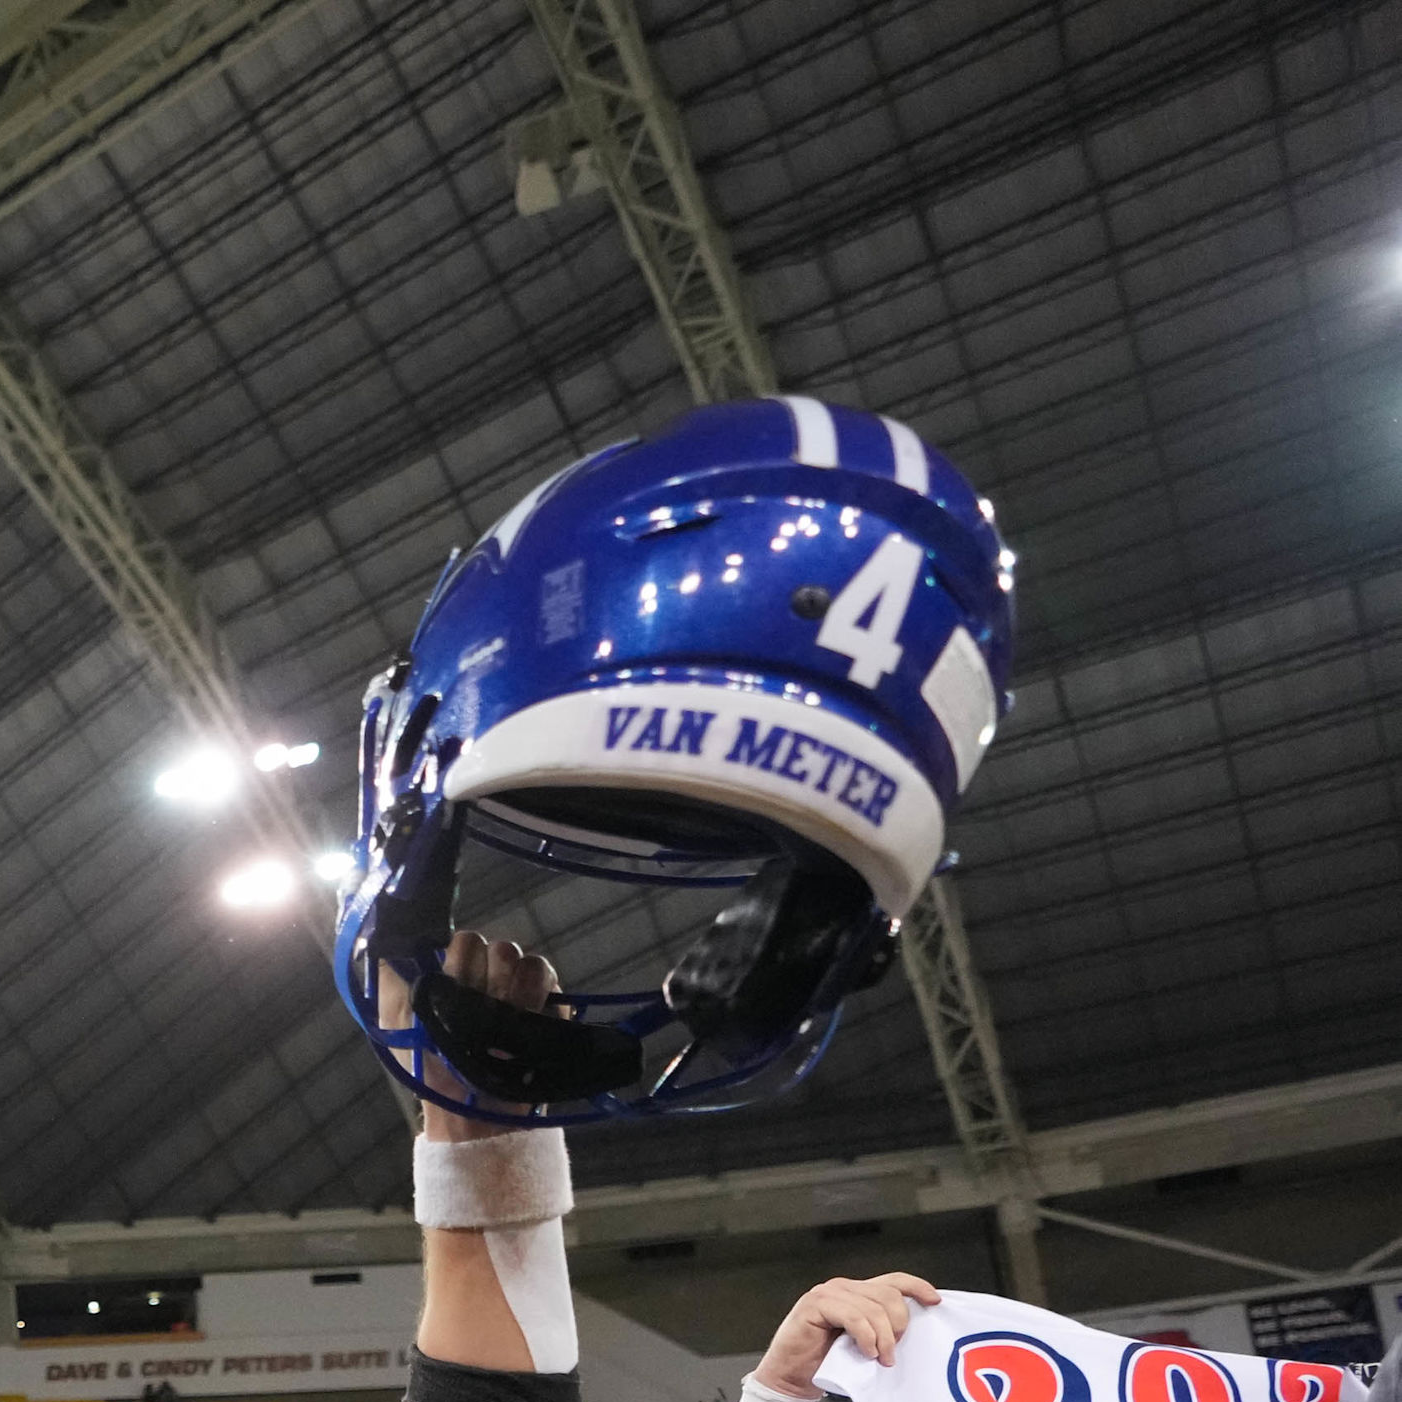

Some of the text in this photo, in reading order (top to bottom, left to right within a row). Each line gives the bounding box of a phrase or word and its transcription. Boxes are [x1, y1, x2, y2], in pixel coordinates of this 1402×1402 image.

[815, 533, 925, 690] 4
[603, 705, 903, 828] VAN METER
[46, 1361, 107, 1382] DAVE
[117, 1362, 132, 1379] &
[140, 1358, 215, 1379] CINDY
[221, 1352, 314, 1376] PETERS
[320, 1349, 390, 1372] SUITE
